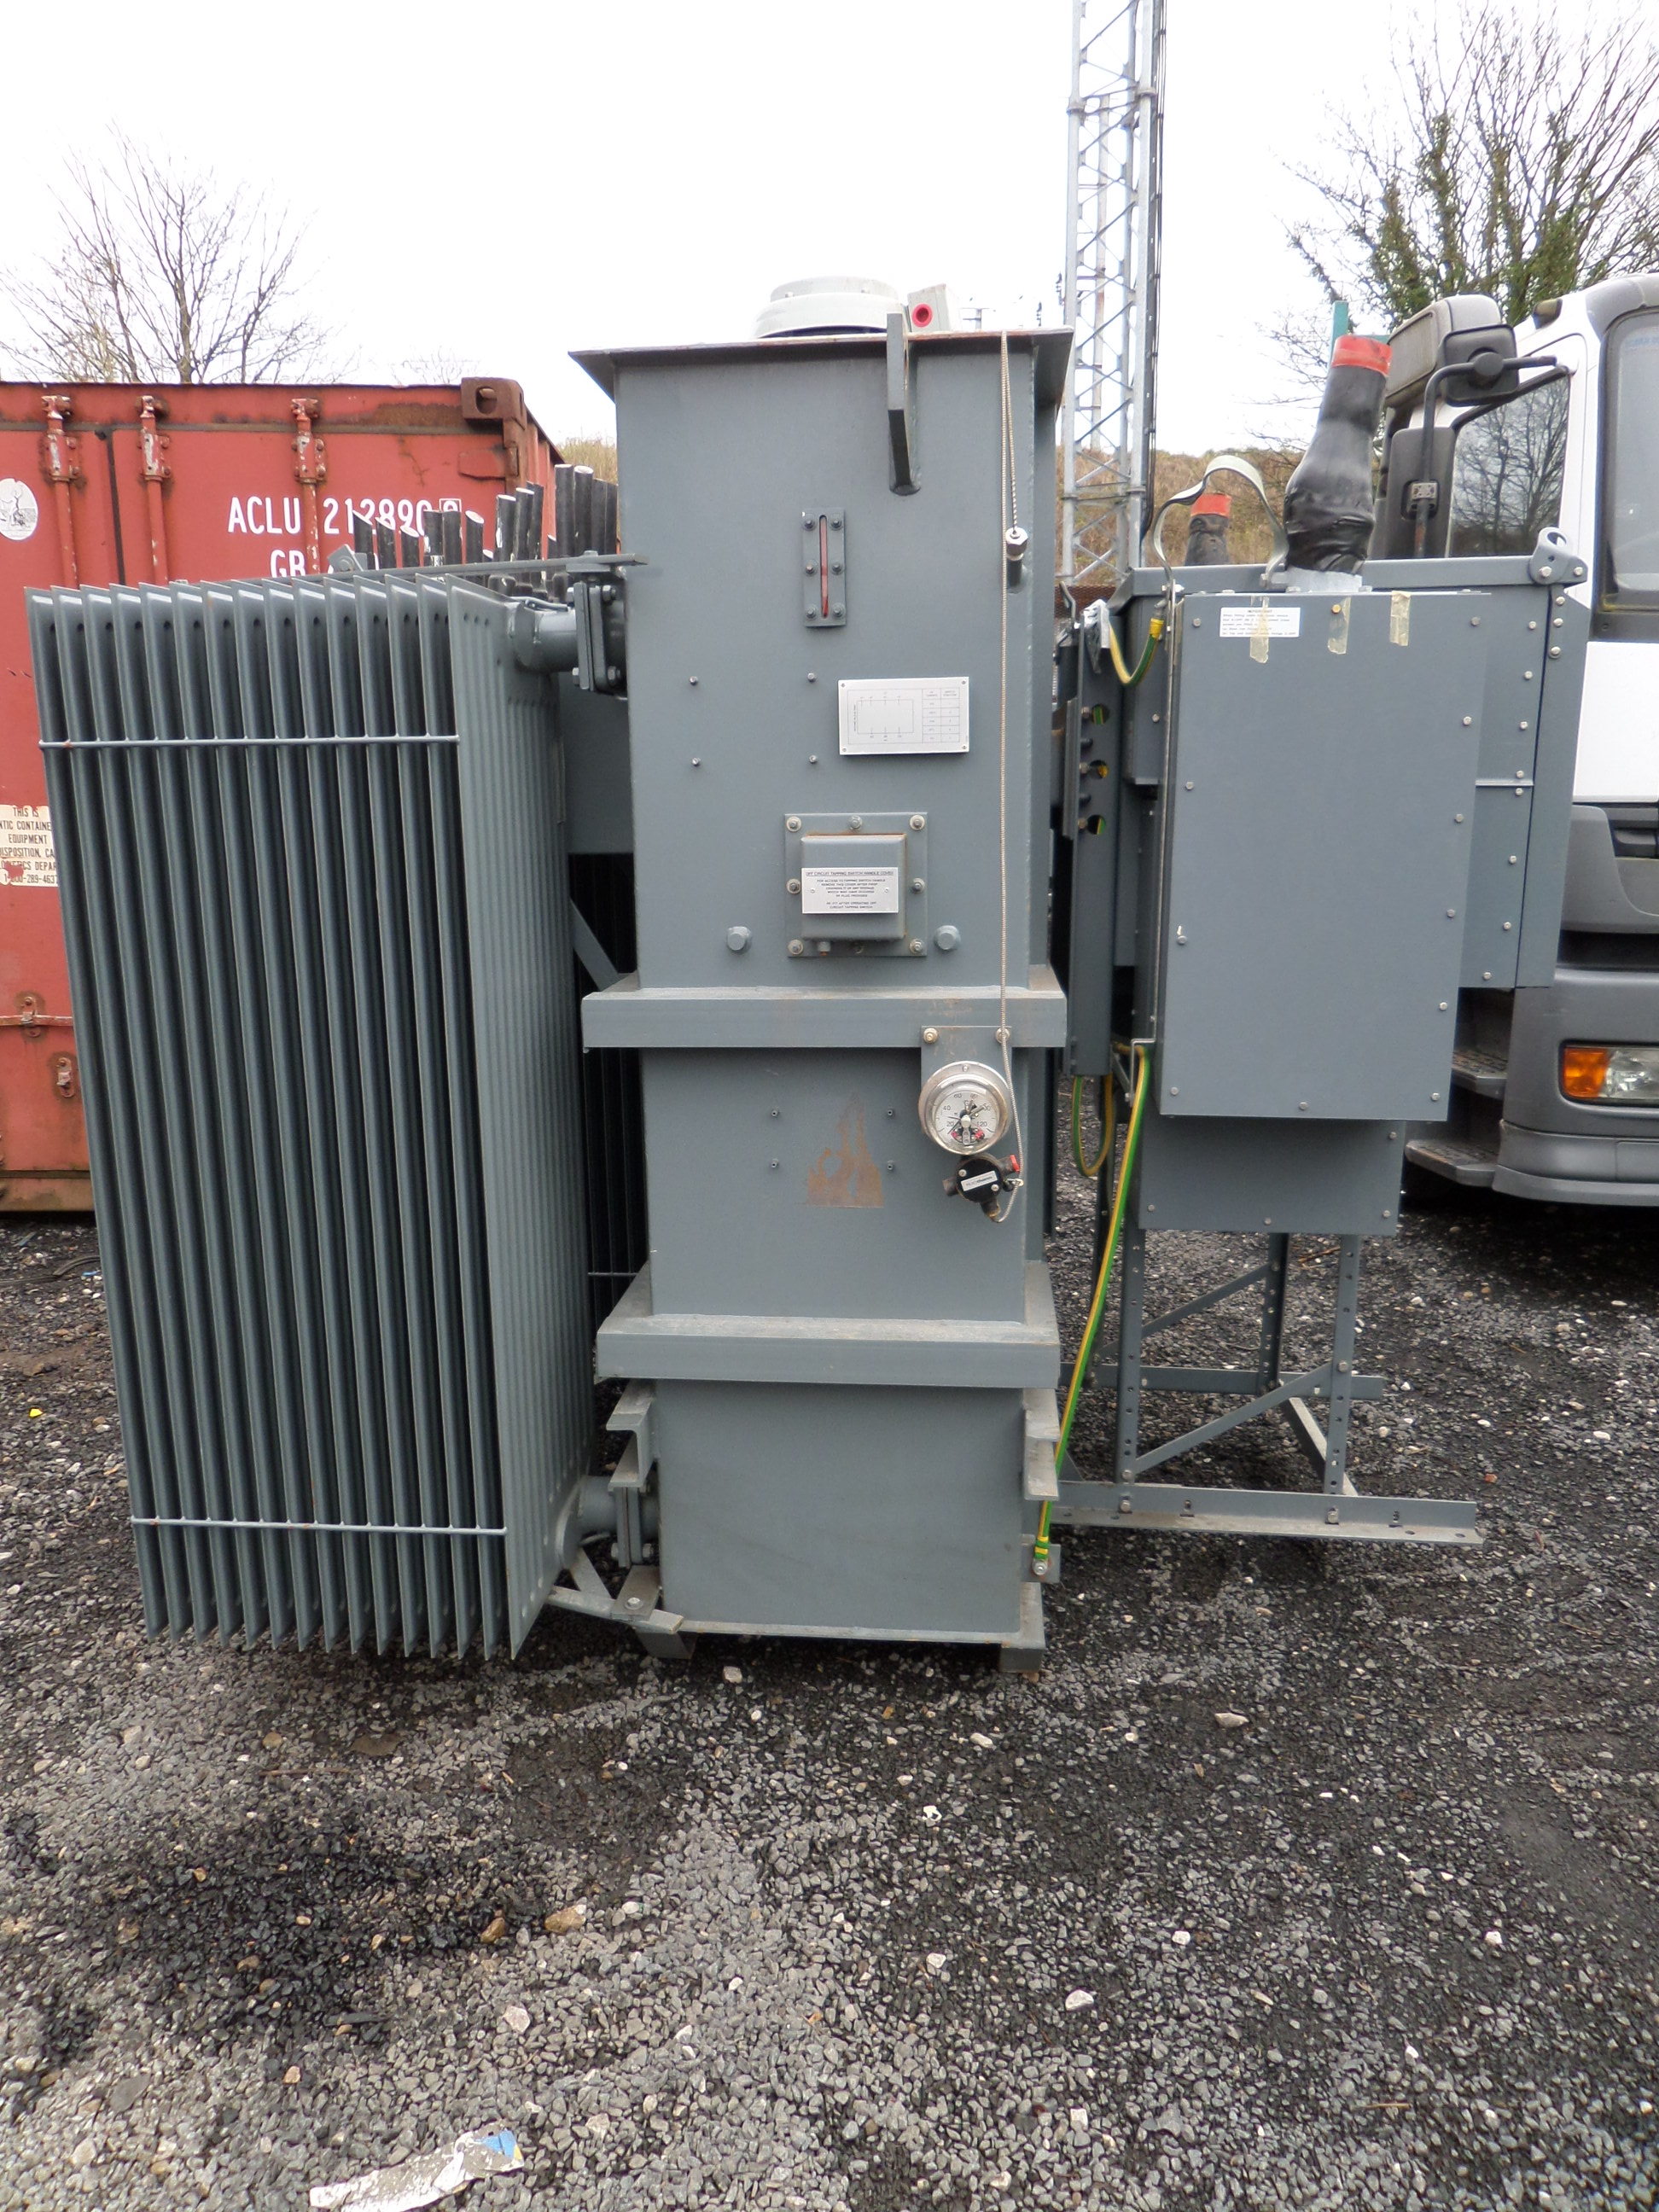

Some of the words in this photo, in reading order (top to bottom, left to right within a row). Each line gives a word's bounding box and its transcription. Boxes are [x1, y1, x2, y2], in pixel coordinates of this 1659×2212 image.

[228, 497, 301, 534] ACLU
[13, 807, 29, 818] THIS
[8, 834, 47, 845] EQUIPMENT
